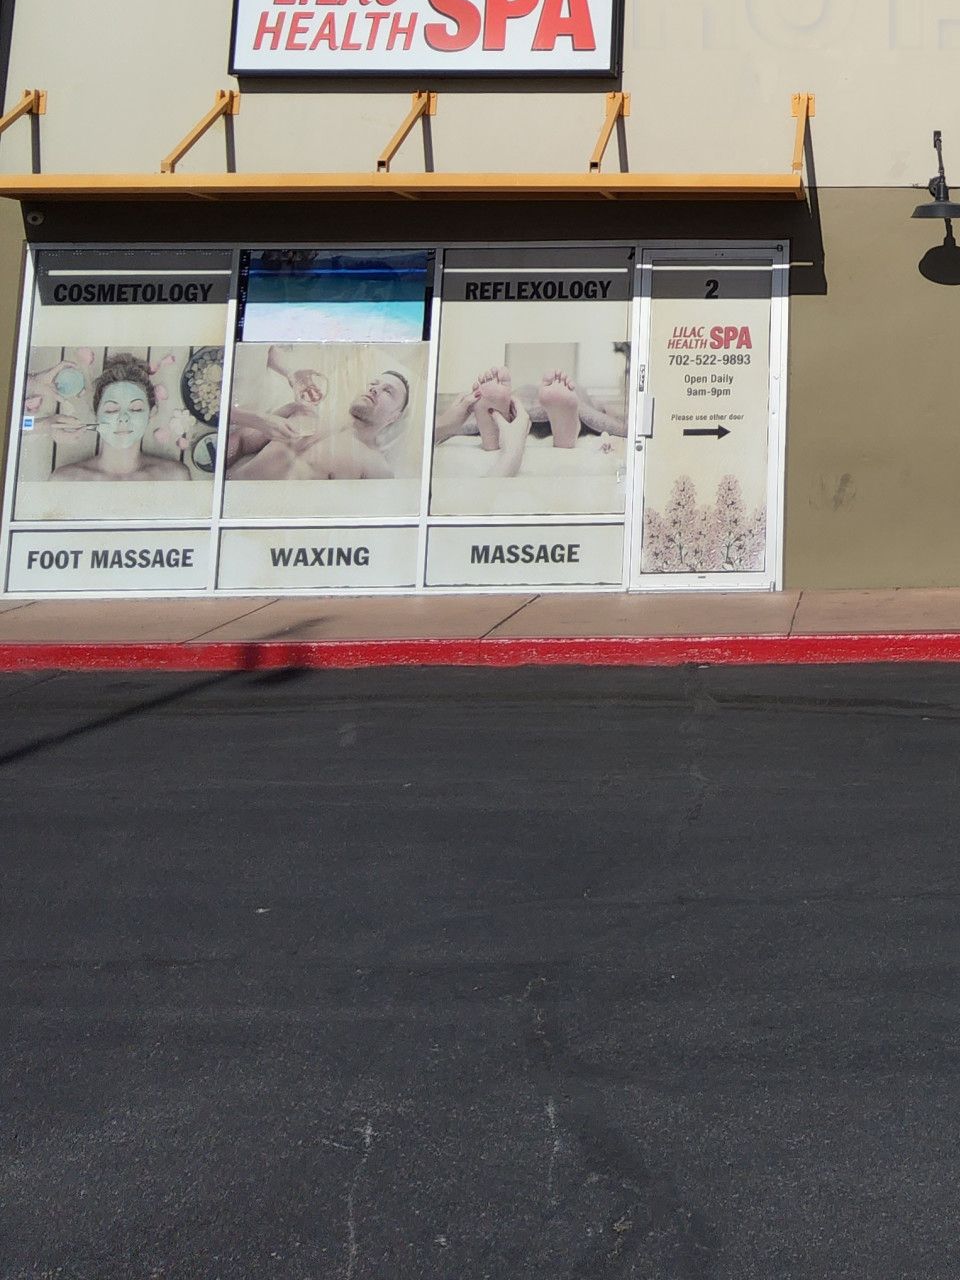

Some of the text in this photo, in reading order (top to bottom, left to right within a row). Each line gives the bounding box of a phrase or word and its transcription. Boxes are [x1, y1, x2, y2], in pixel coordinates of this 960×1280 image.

[254, 11, 418, 50] HEALTH
[53, 282, 214, 304] COSMETOLOGY
[464, 279, 613, 302] REFLEXOLOGY
[704, 279, 719, 299] 2
[667, 326, 752, 349] HEALTH SPA
[673, 326, 705, 338] LILAC
[668, 354, 751, 366] 702-522-9893
[684, 374, 734, 385] Open Daily
[686, 387, 731, 398] 9am-9pm
[671, 413, 693, 421] Please
[709, 413, 727, 421] other
[728, 413, 745, 421] door
[27, 548, 194, 570] FOOT MASSAGE
[270, 546, 370, 567] WAXING
[470, 544, 581, 564] MASSAGE
